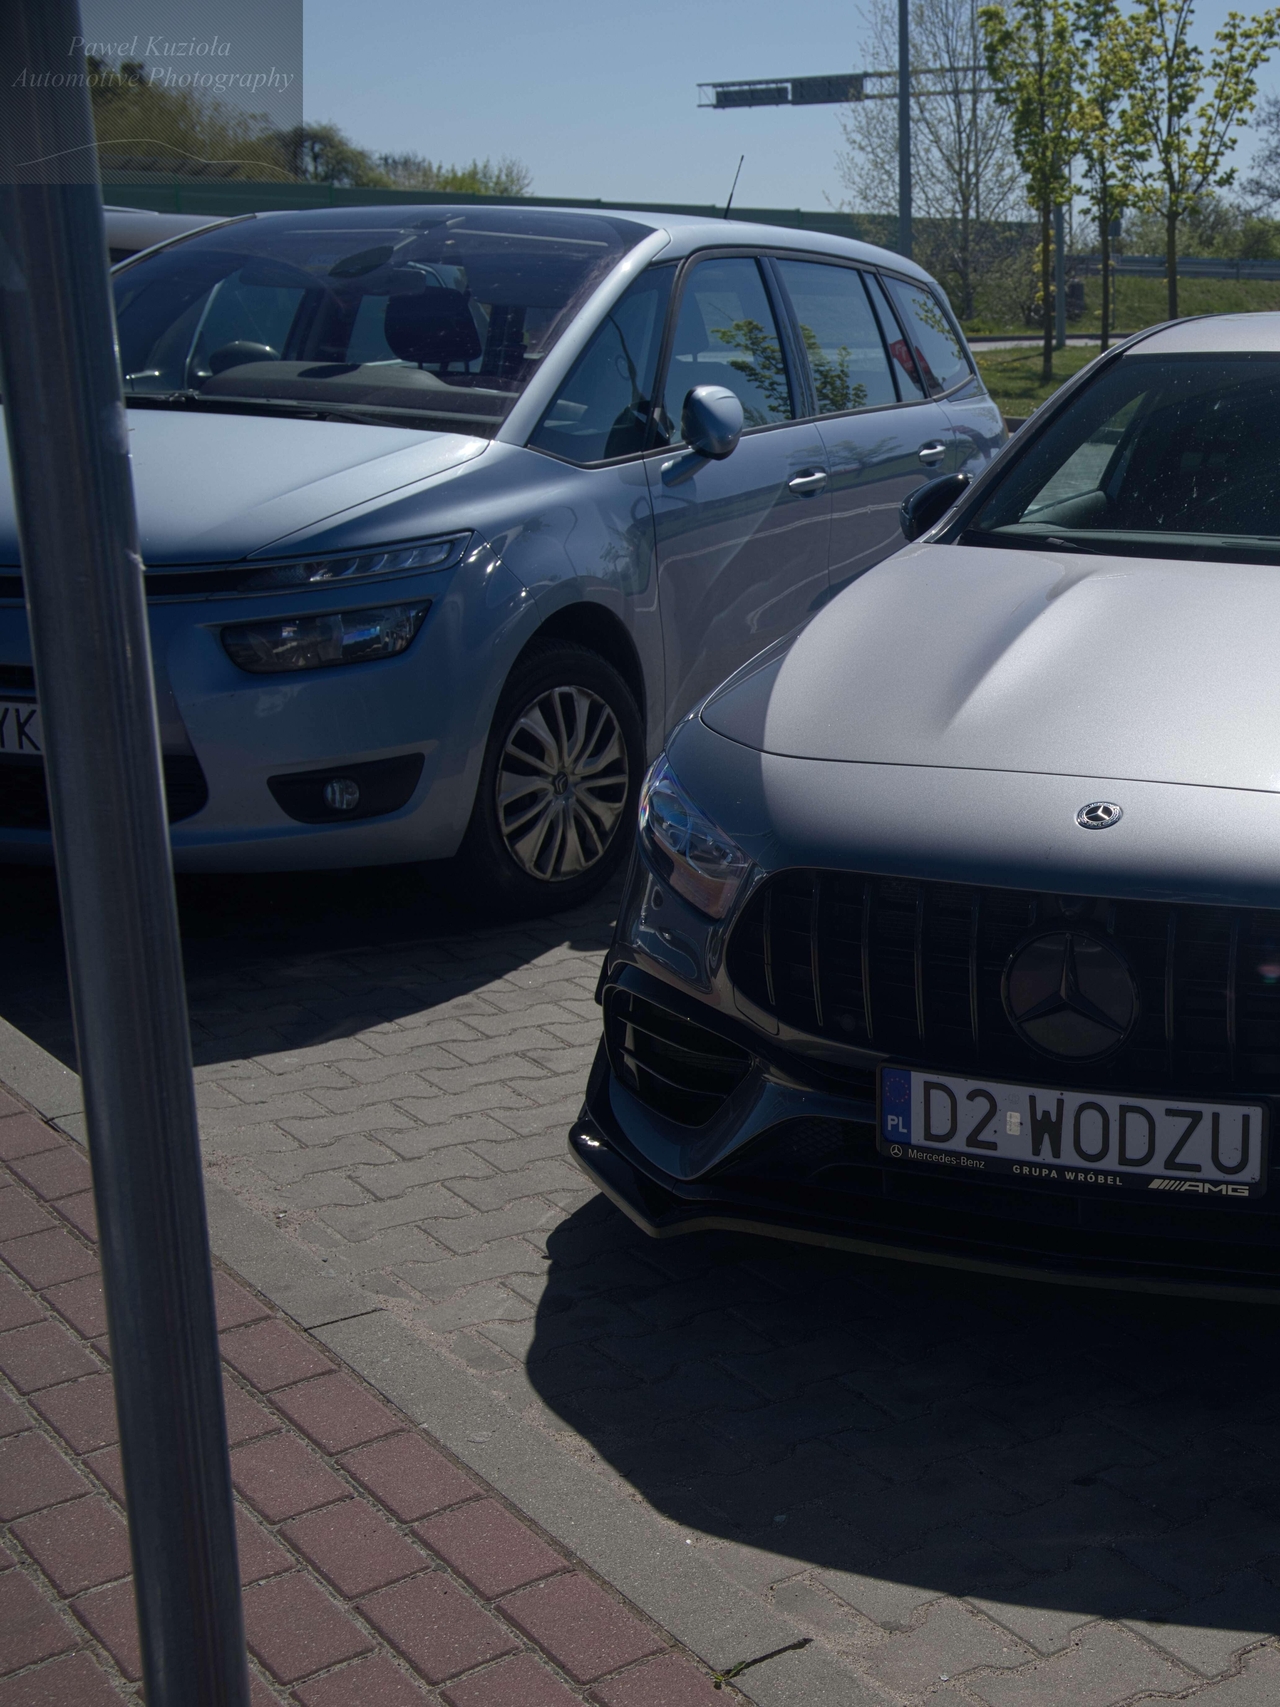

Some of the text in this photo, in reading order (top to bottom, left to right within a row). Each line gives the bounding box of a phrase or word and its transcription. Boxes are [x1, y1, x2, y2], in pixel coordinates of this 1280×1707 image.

[887, 1115, 908, 1133] PL
[923, 1081, 1250, 1175] D2 WODZU
[908, 1148, 985, 1169] Mercedes-Benz
[1012, 1165, 1123, 1186] GRUPA WRÓBEL
[1181, 1181, 1250, 1197] AMG
